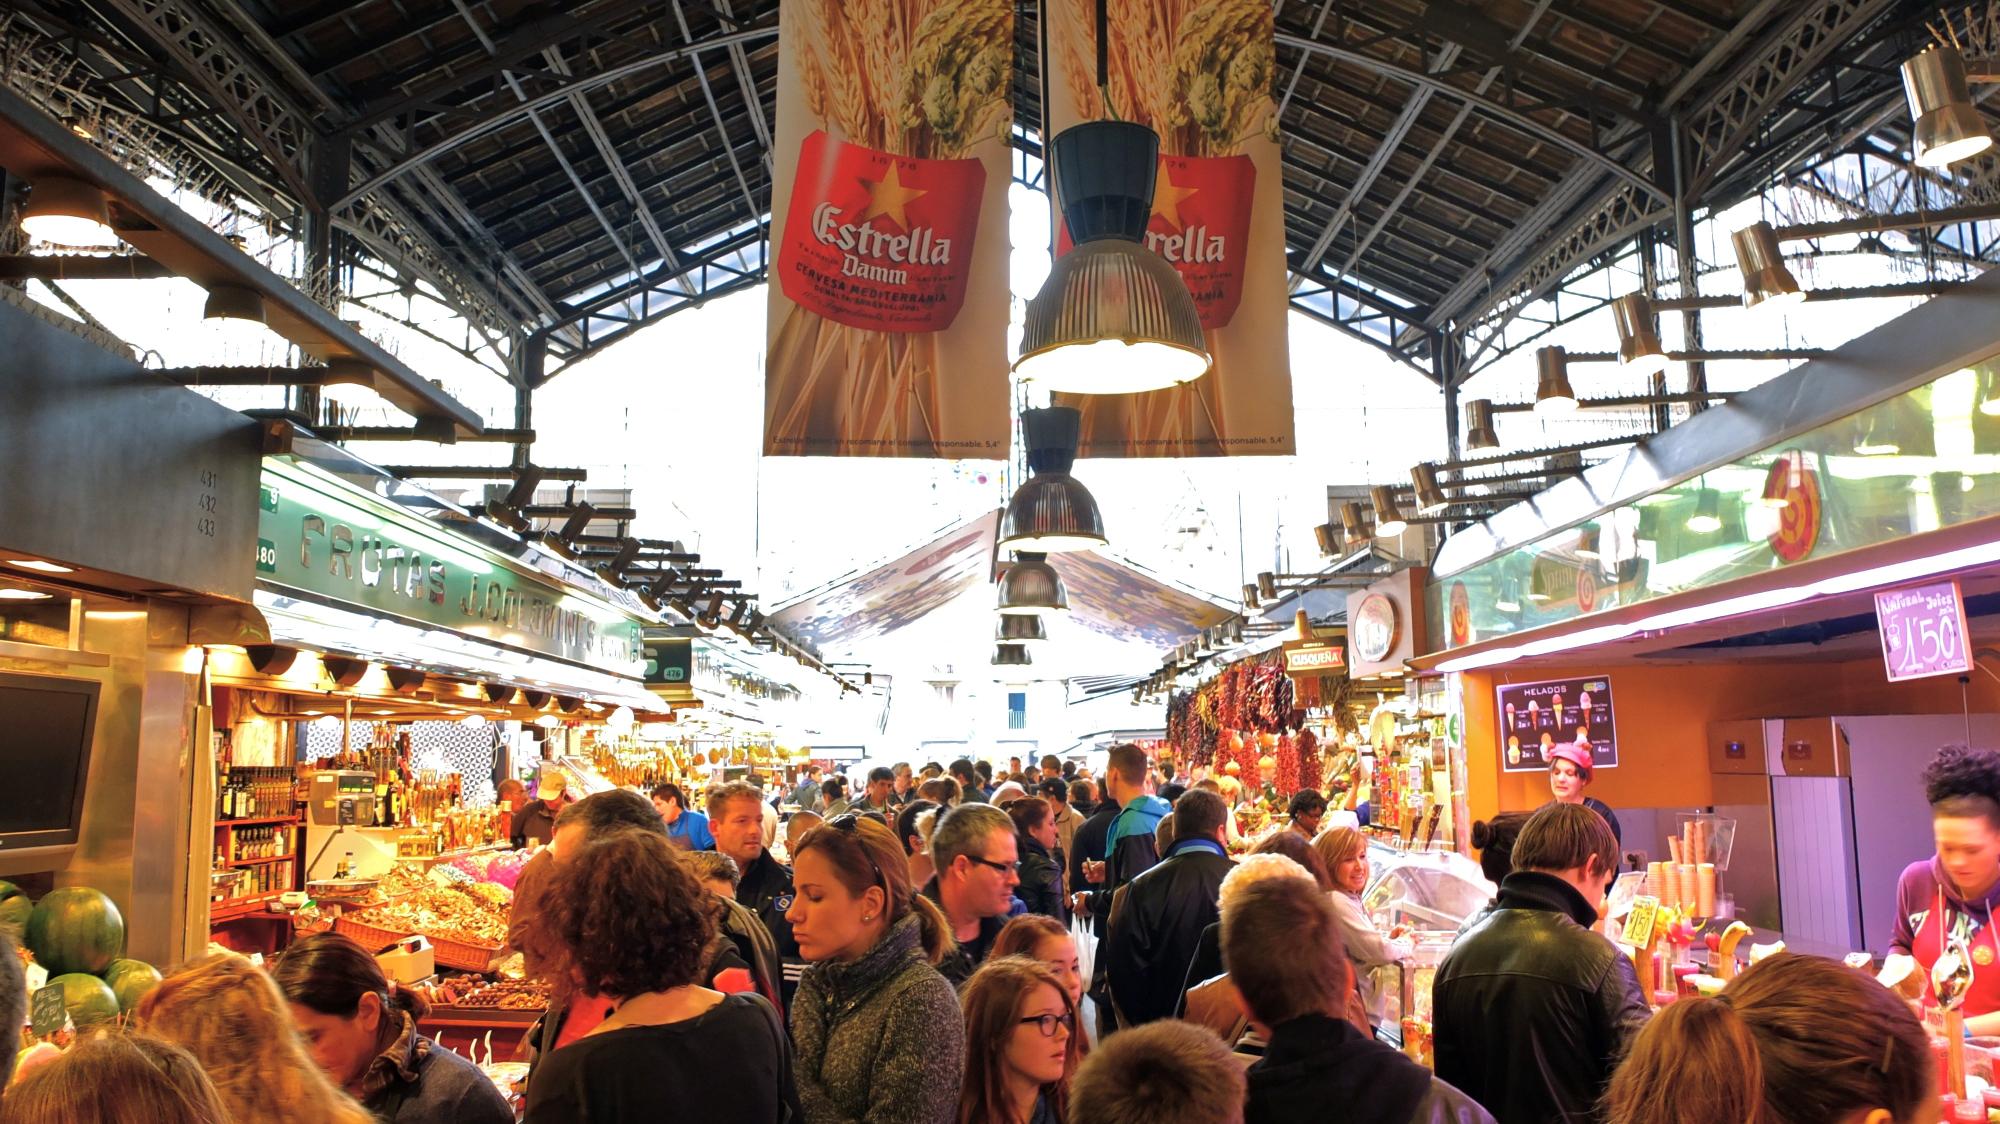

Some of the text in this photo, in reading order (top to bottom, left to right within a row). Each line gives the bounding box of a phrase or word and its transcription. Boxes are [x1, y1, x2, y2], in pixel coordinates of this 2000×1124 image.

[812, 202, 951, 265] Estrella
[1145, 225, 1225, 263] rella
[841, 253, 908, 285] Damm
[200, 469, 217, 489] 431
[199, 493, 217, 514] 432
[197, 518, 215, 537] 433
[302, 513, 446, 605] FRUTAS
[1291, 651, 1339, 666] CUSQUEÑA
[1524, 685, 1567, 696] HELADOS
